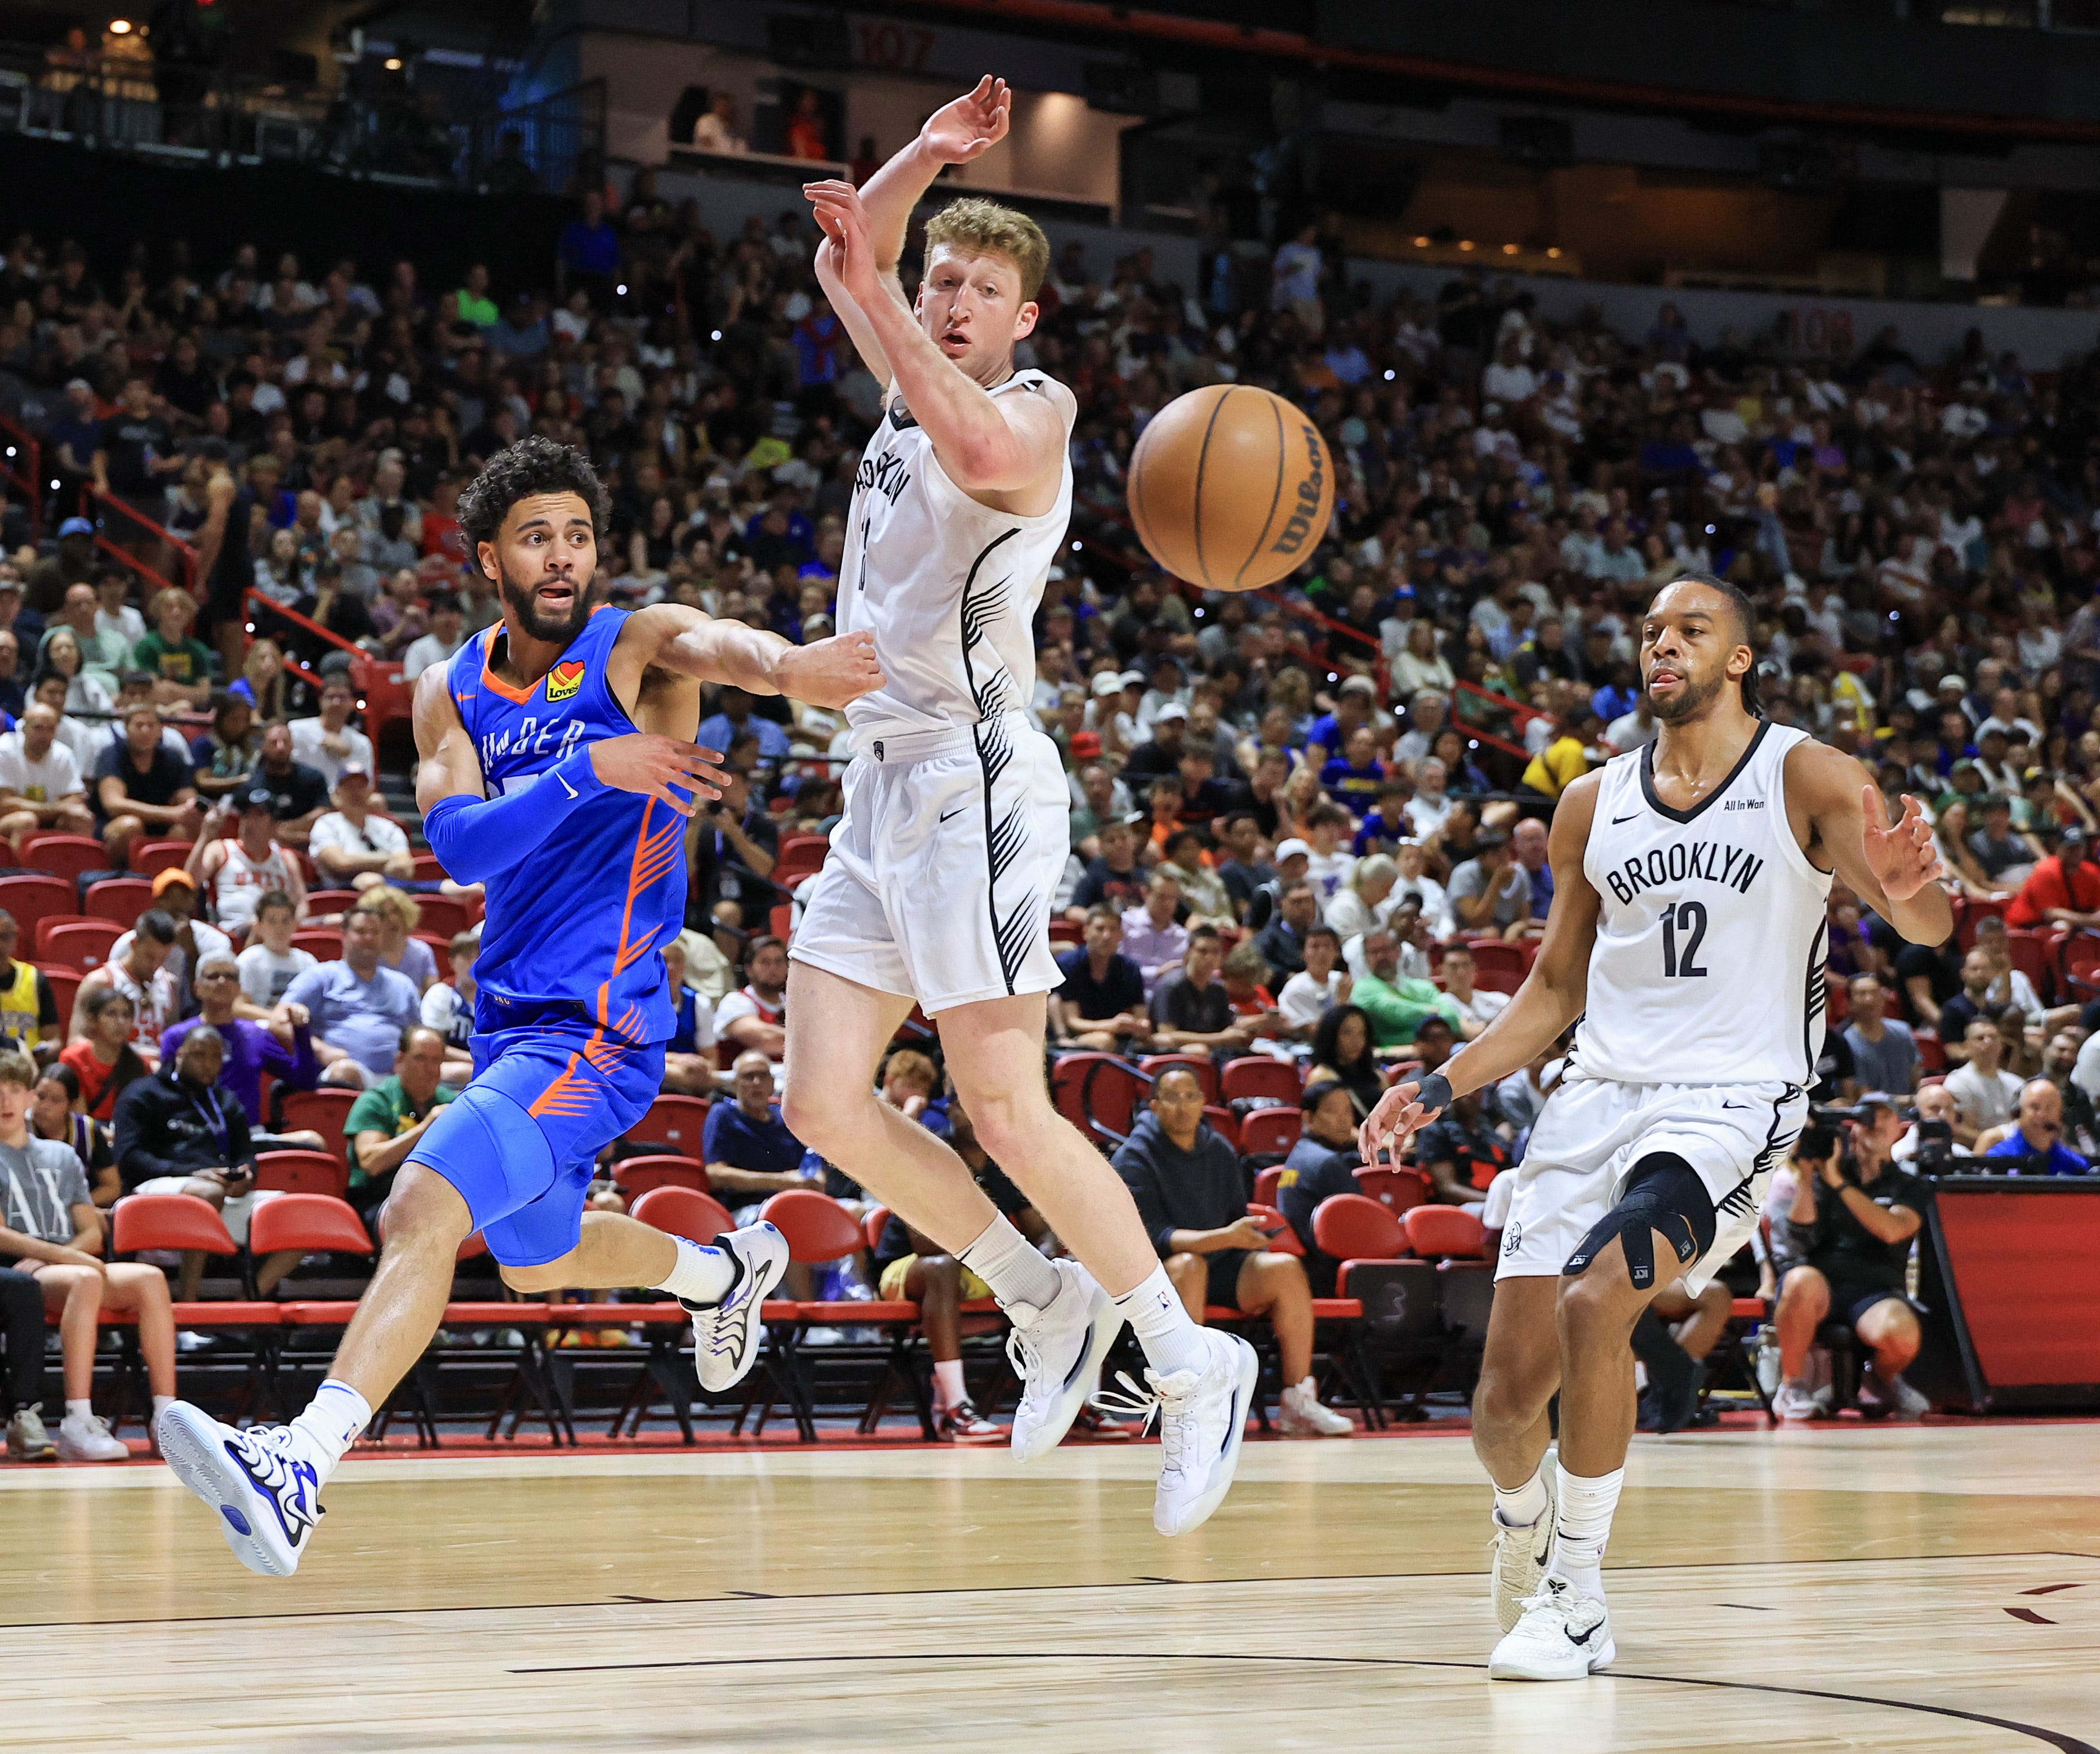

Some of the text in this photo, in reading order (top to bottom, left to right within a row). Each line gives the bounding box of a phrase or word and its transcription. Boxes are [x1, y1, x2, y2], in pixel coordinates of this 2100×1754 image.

[858, 21, 935, 72] 107
[1724, 800, 1736, 811] All
[1737, 800, 1745, 810] In
[1606, 841, 1764, 906] BROOKLYN
[1658, 901, 1707, 977] 12
